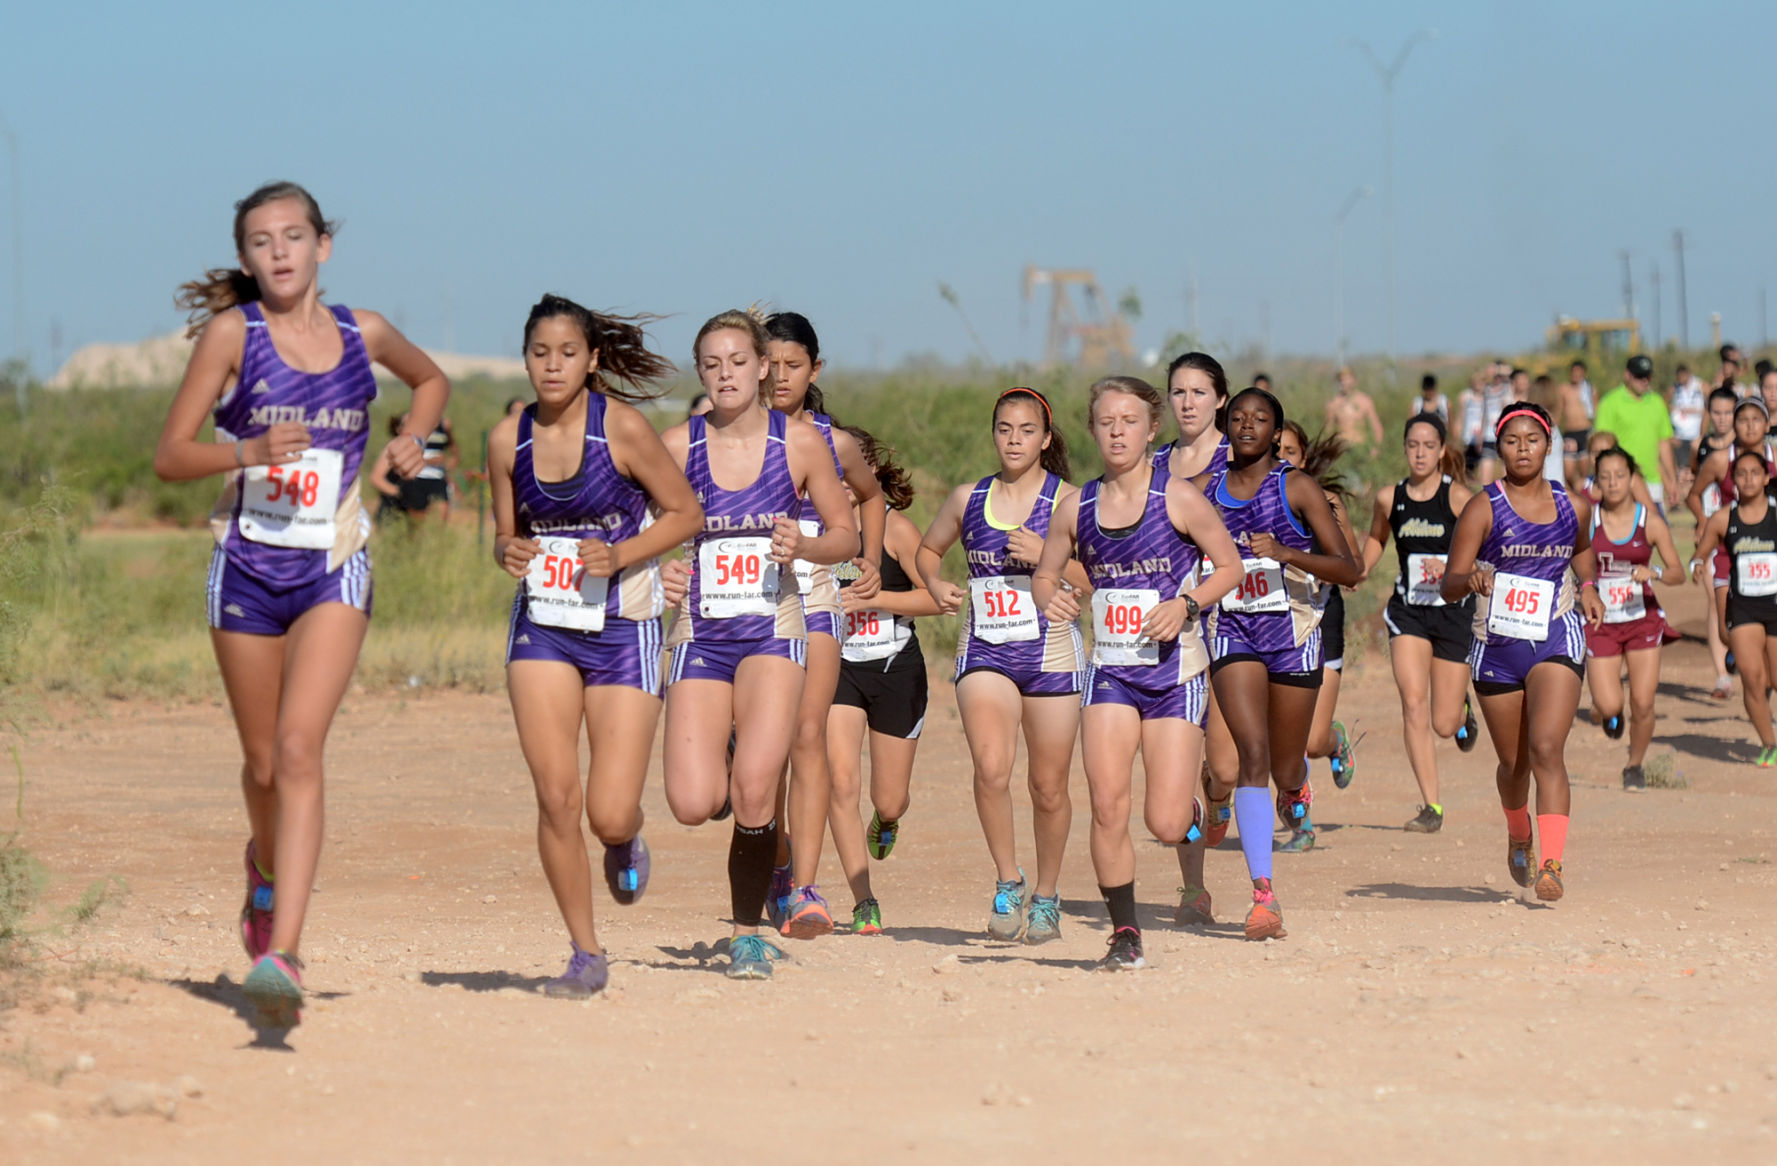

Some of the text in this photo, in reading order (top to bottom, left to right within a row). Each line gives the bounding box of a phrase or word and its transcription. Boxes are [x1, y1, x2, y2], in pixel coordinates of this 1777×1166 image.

[248, 405, 365, 431] MIDLAND
[266, 466, 319, 507] 548
[1501, 544, 1573, 559] MIDLAND
[716, 554, 760, 585] 549
[984, 590, 1021, 618] 512
[1505, 588, 1540, 614] 495
[845, 611, 880, 637] 356
[1104, 604, 1142, 635] 499
